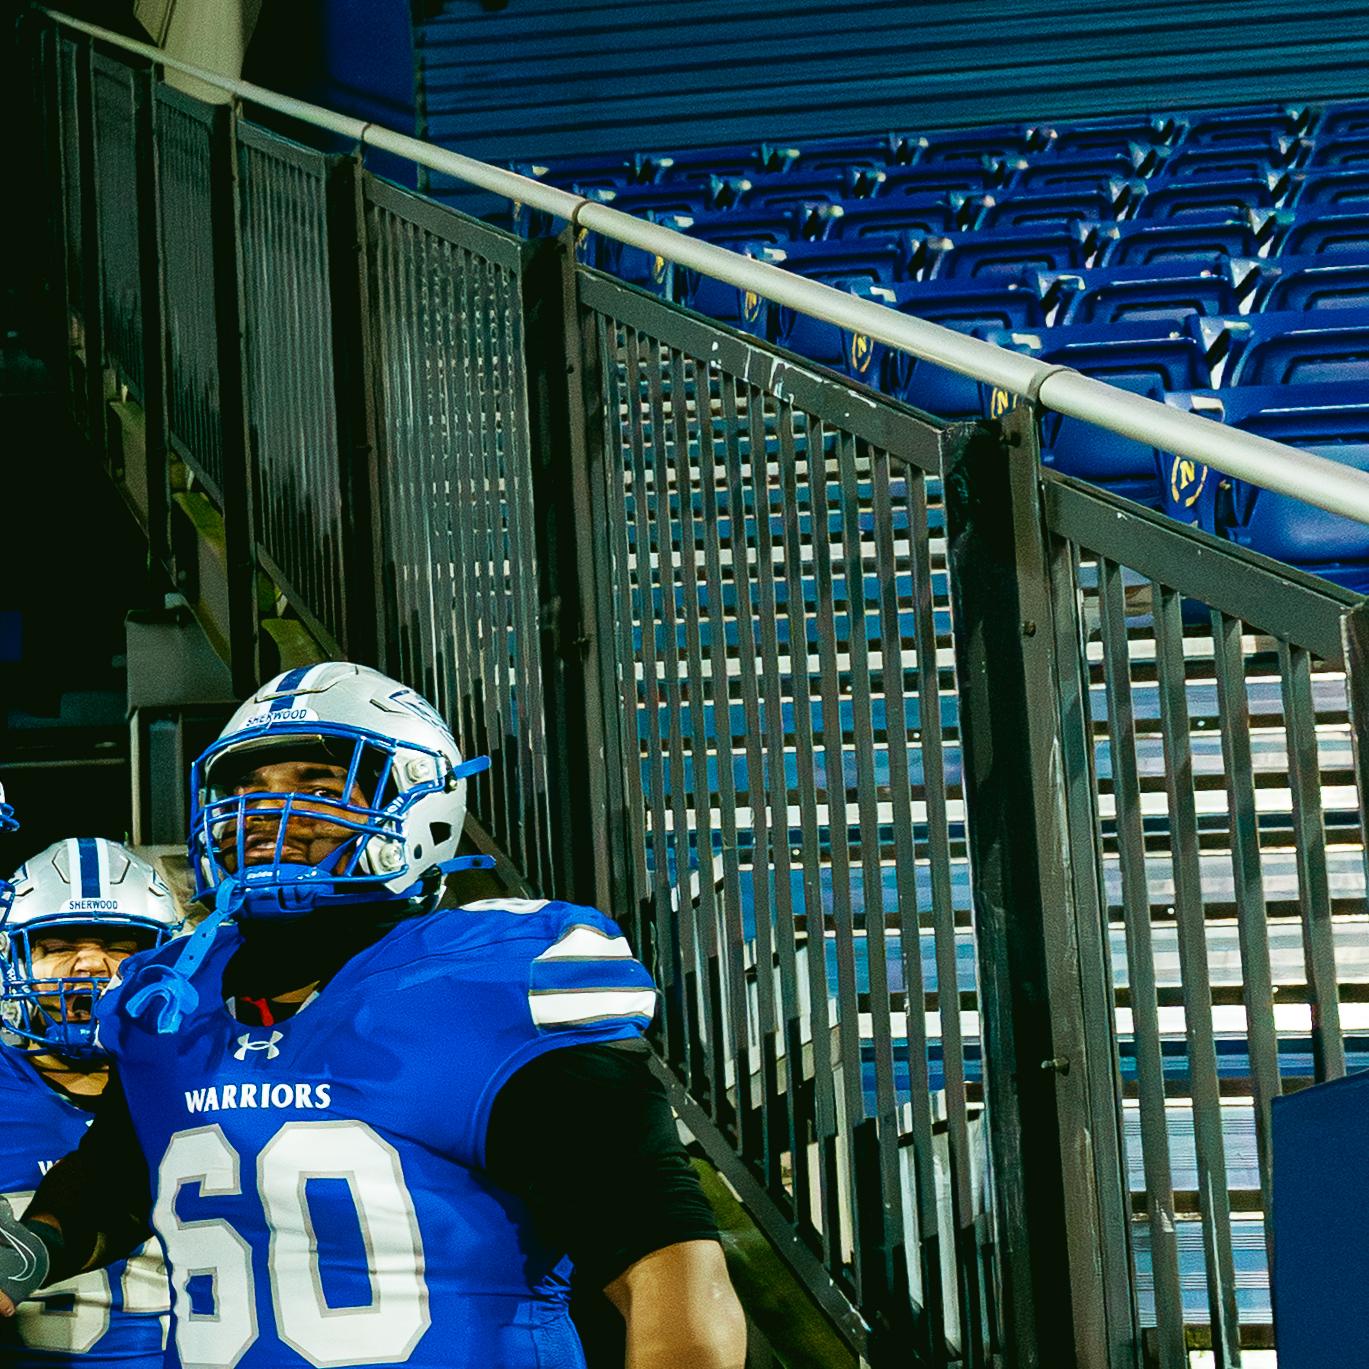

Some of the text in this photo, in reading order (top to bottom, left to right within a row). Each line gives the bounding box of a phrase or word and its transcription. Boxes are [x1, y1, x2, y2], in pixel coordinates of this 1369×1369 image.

[1180, 459, 1196, 490] N
[69, 900, 119, 911] SHERWOOD
[184, 1083, 332, 1113] WARRIORS
